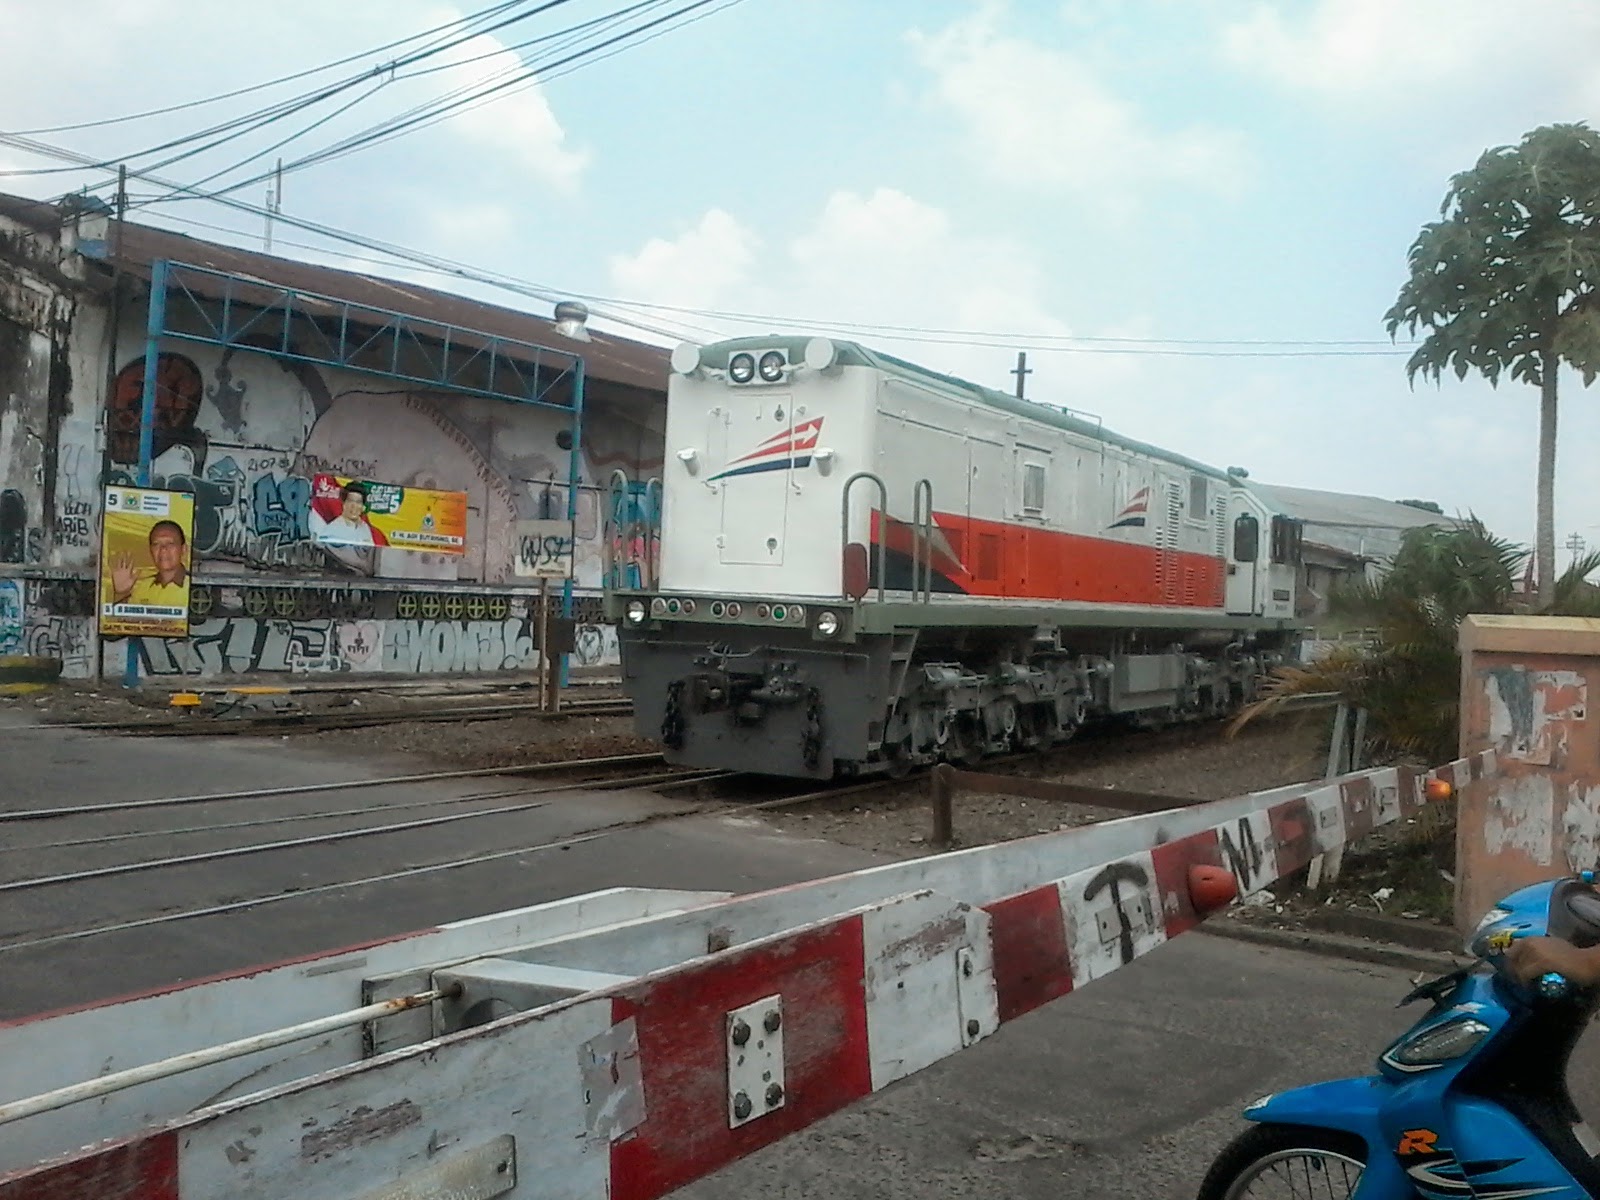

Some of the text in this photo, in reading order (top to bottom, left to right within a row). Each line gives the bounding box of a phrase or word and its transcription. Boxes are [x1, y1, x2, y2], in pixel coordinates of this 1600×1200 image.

[107, 493, 118, 506] 5
[389, 493, 400, 514] 5
[1398, 1128, 1439, 1155] R
